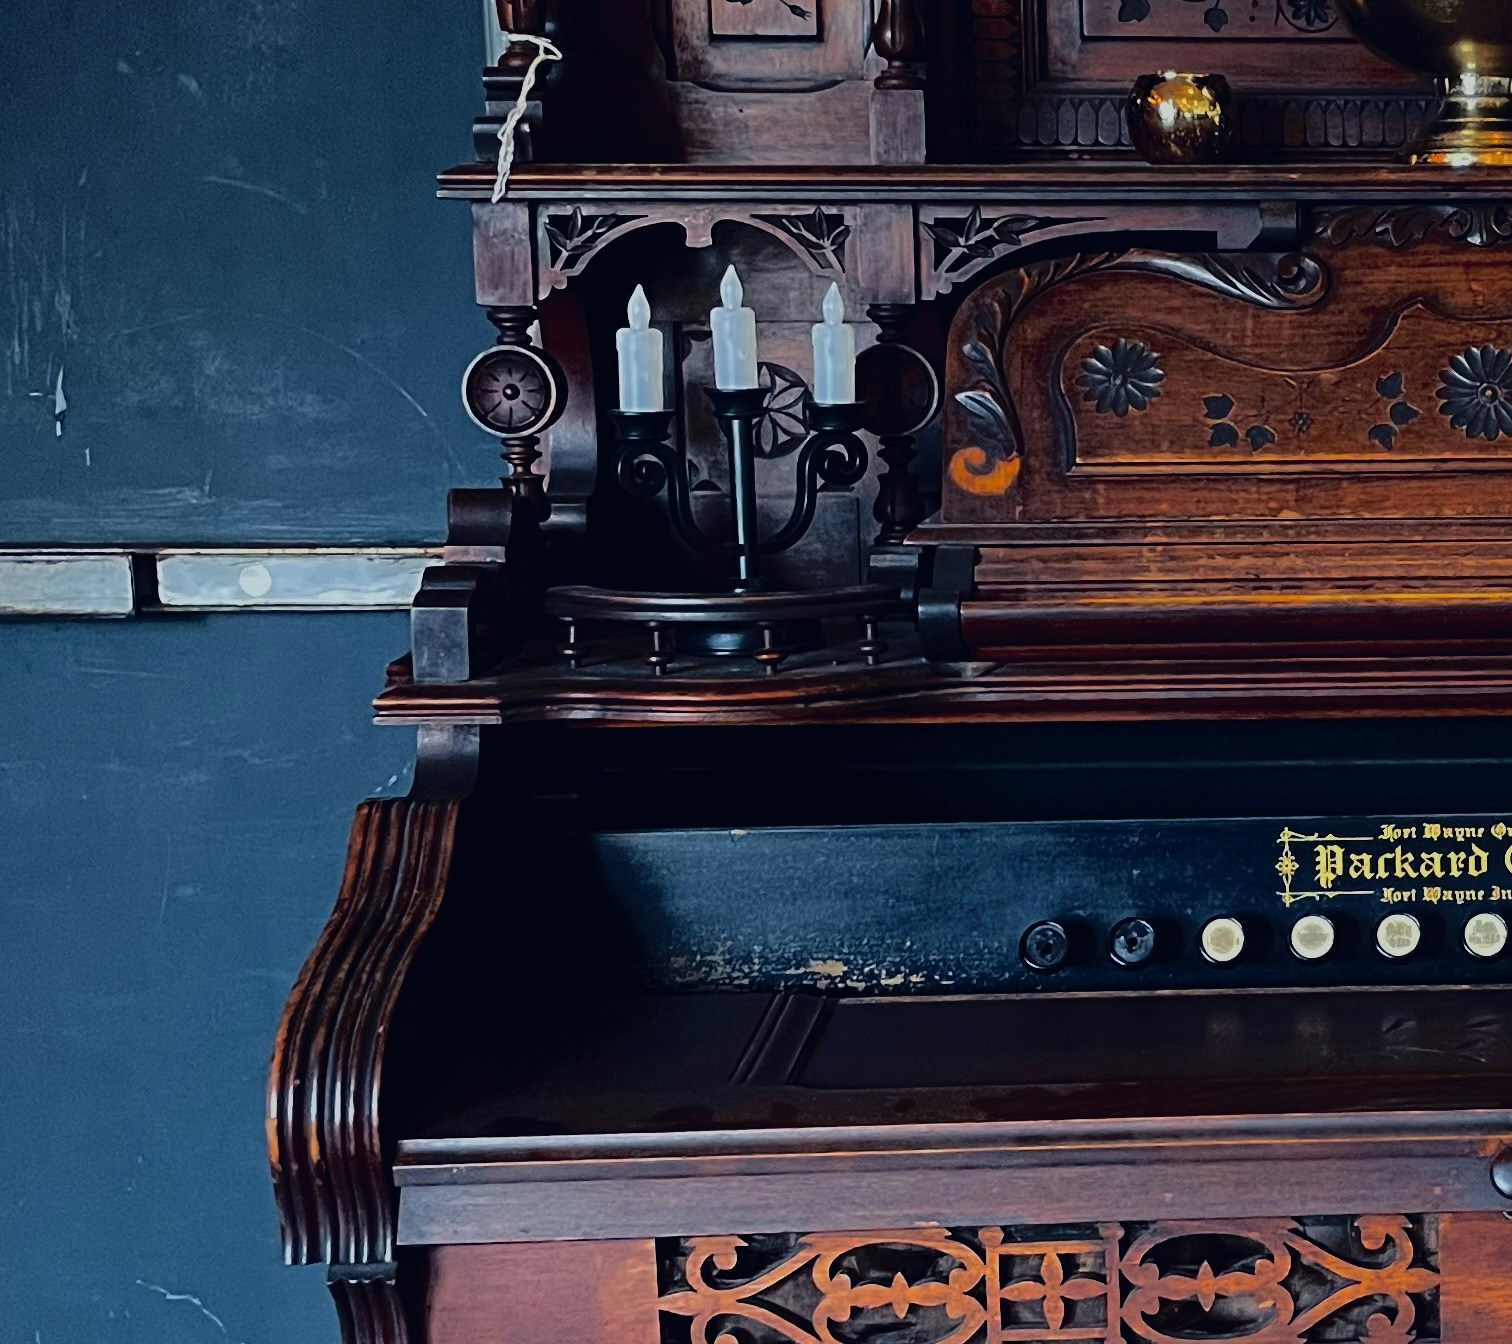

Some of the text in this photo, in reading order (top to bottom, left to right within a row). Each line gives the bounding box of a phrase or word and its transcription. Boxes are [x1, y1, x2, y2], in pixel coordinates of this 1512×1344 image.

[1422, 822, 1485, 842] Wayne
[1314, 843, 1489, 889] Packard
[1422, 886, 1485, 905] Wayne
